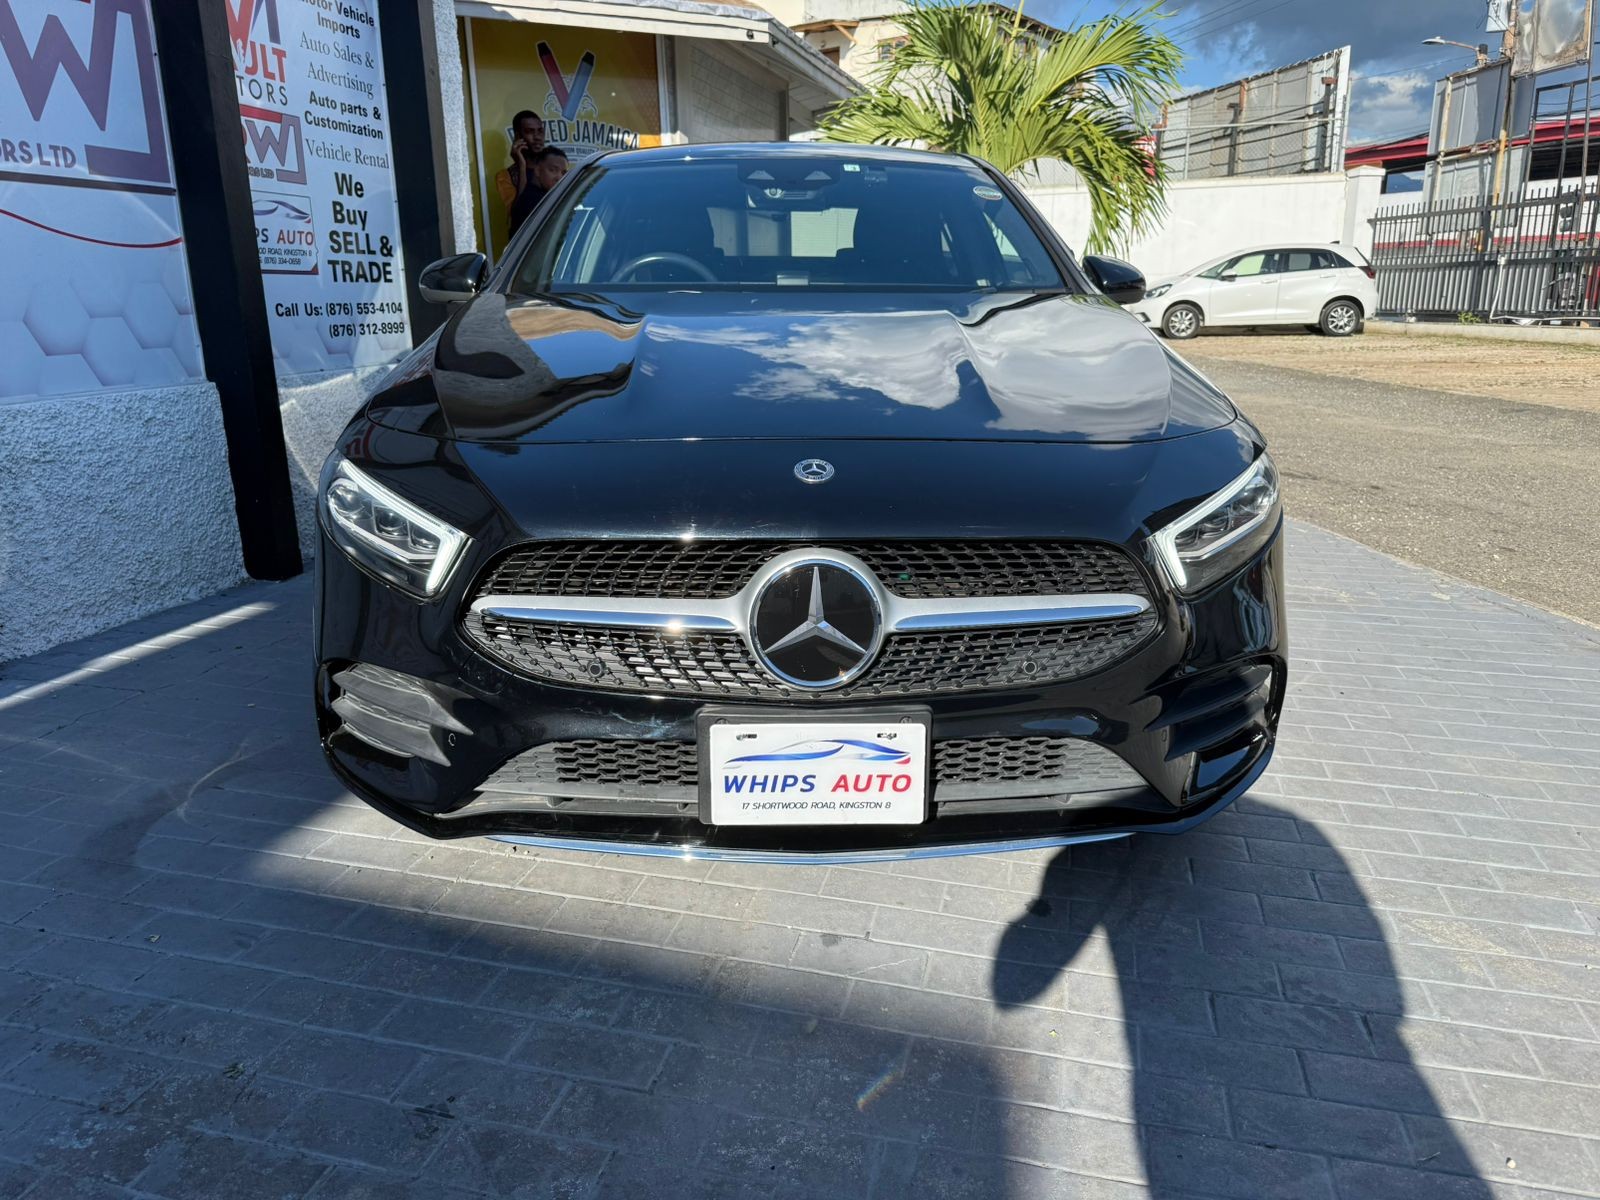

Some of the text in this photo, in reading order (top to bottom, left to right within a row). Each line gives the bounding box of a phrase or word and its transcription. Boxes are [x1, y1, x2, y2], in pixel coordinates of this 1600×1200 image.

[299, 0, 375, 27] otor Vehicle
[317, 11, 360, 39] Imports
[300, 31, 374, 69] Auto Sales &
[307, 62, 374, 99] Advertising
[309, 91, 382, 120] Auto parts &
[304, 110, 384, 140] Customization
[573, 119, 638, 151] JAMAICA
[0, 138, 76, 168] RS LTD
[305, 138, 389, 169] Vehicle Rental
[334, 172, 364, 198] We
[332, 200, 367, 231] Buy
[277, 229, 314, 246] AUTO
[329, 230, 393, 257] SELL &
[327, 259, 393, 283] TRADE
[275, 301, 403, 317] Call Us: (876) 553-4104
[329, 322, 405, 338] (876) 312-8999
[724, 774, 912, 793] WHIPS AUTO
[752, 802, 808, 810] SHORTWOOD
[810, 802, 836, 811] ROAD,
